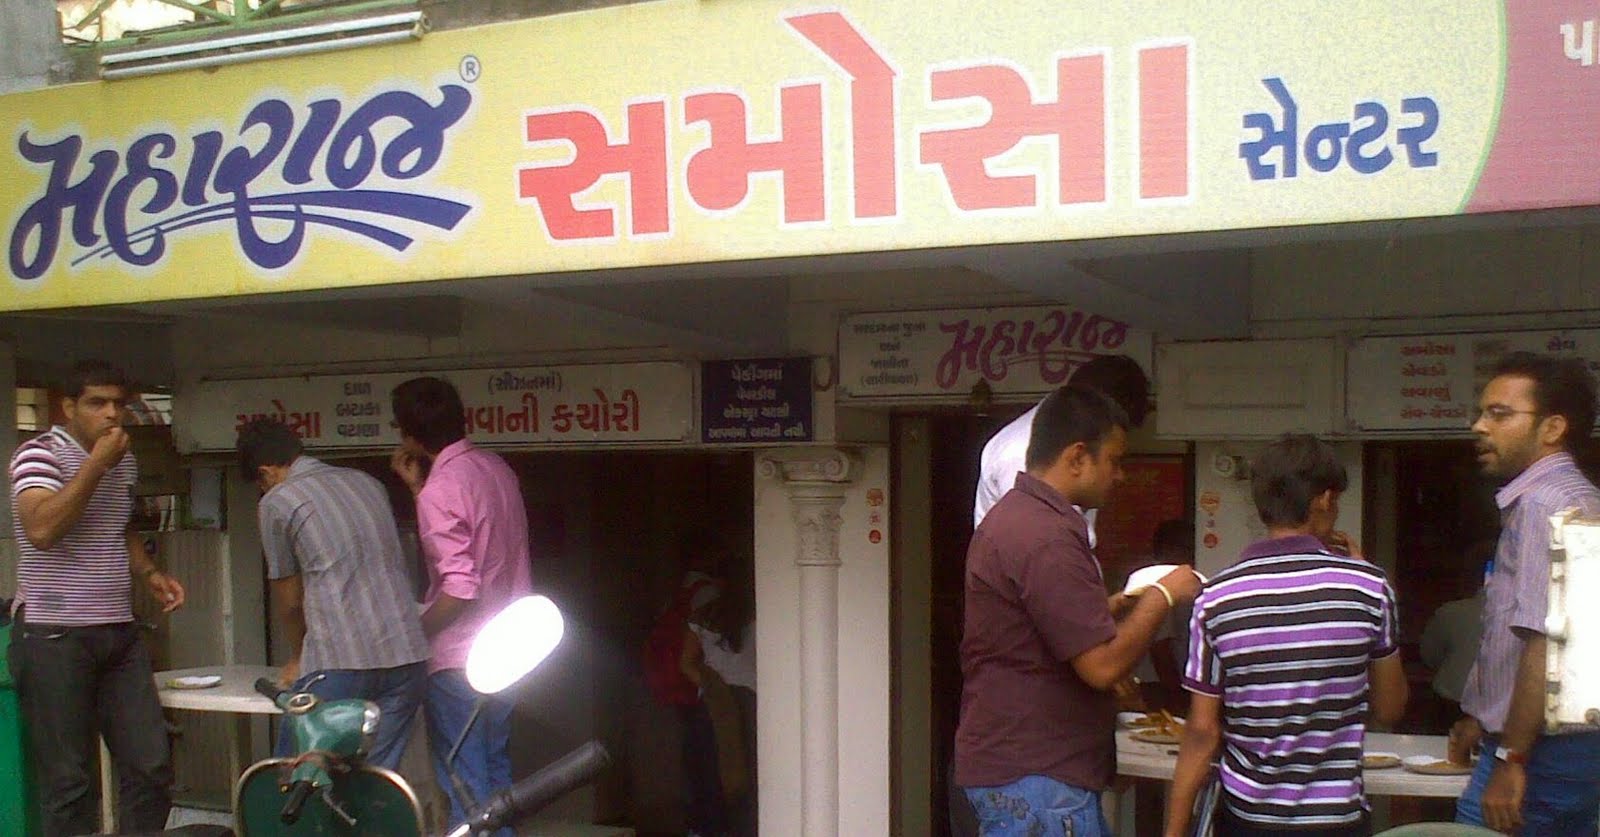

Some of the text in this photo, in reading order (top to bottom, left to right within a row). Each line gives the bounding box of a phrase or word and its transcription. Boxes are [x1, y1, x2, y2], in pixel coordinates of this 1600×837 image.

[8, 12, 1440, 280] મહારાજ સમોસા સેન્ટર
[935, 310, 1130, 390] મહારાજ
[551, 388, 640, 433] કચોરી
